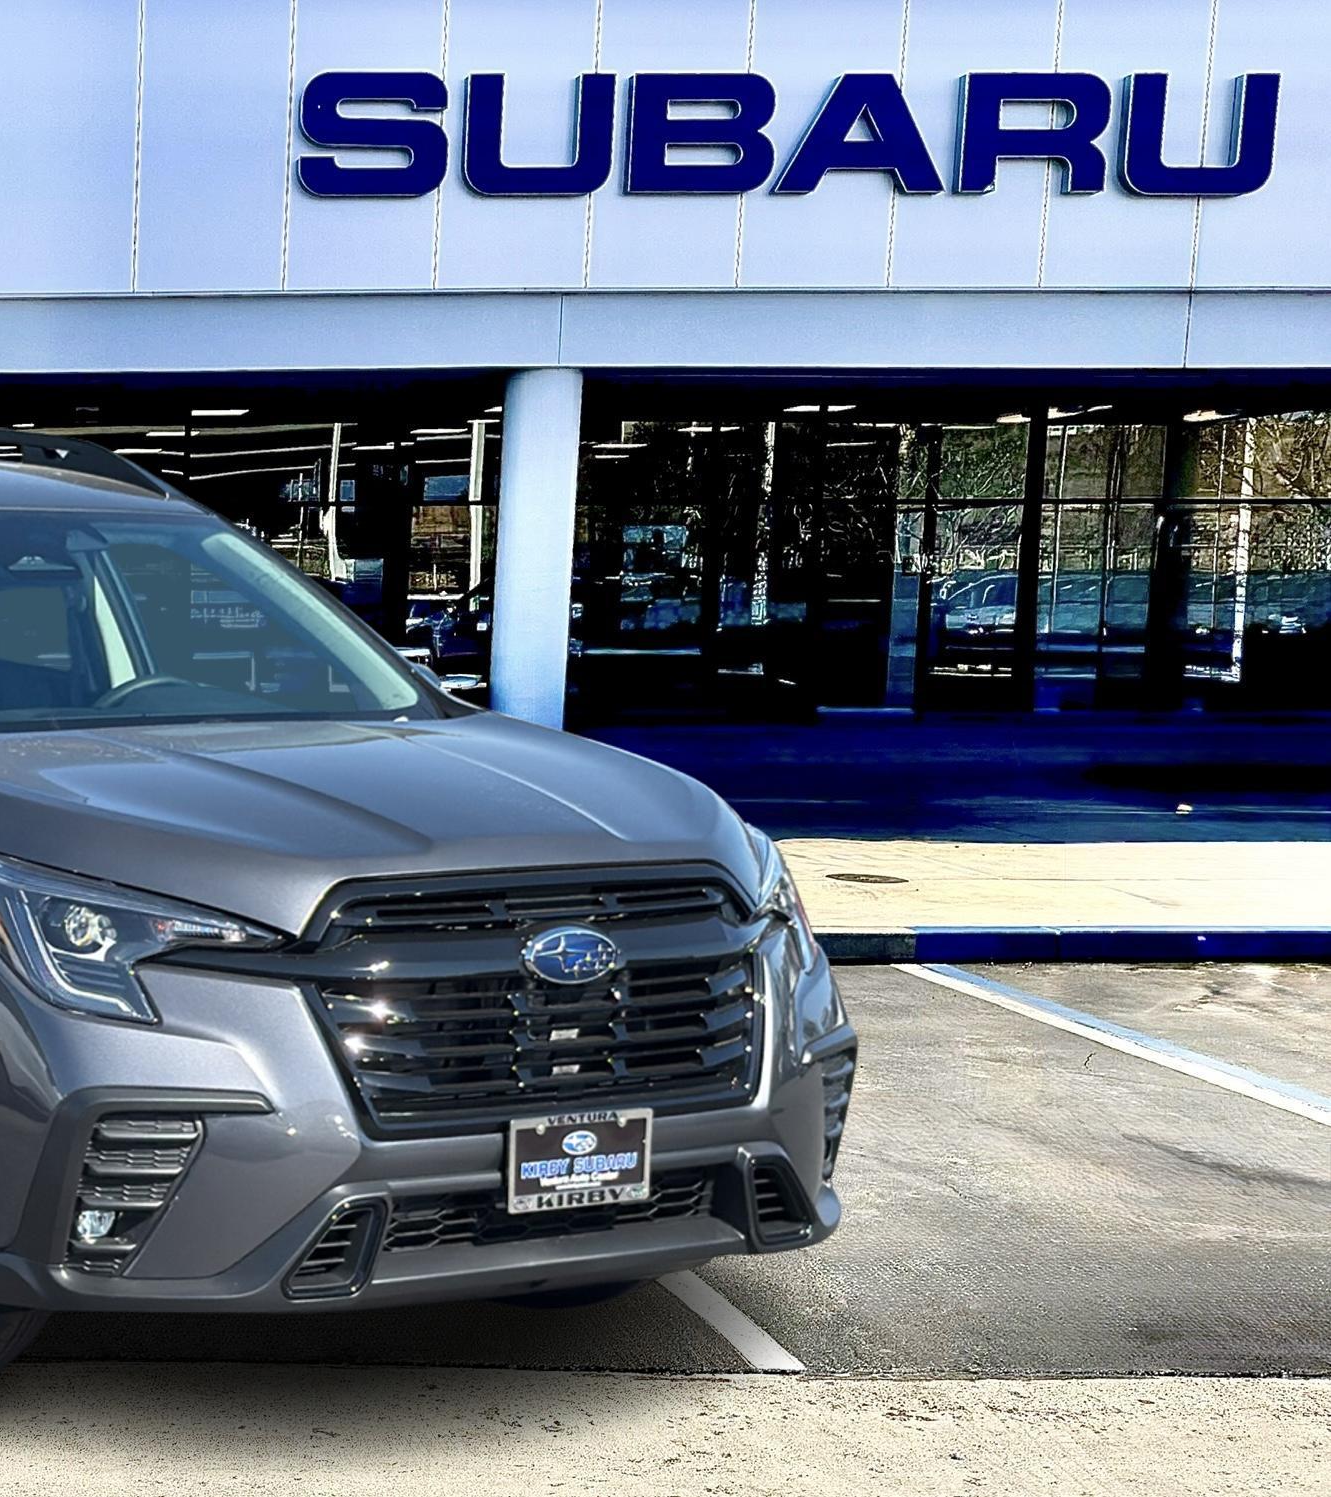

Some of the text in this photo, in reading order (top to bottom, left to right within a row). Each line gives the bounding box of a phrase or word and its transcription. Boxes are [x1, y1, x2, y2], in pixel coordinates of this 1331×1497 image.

[296, 70, 1281, 198] SUBARU
[548, 1112, 618, 1125] VENTURA
[521, 1152, 638, 1179] KIRBY SUBARU
[537, 1188, 624, 1208] KIRBY
